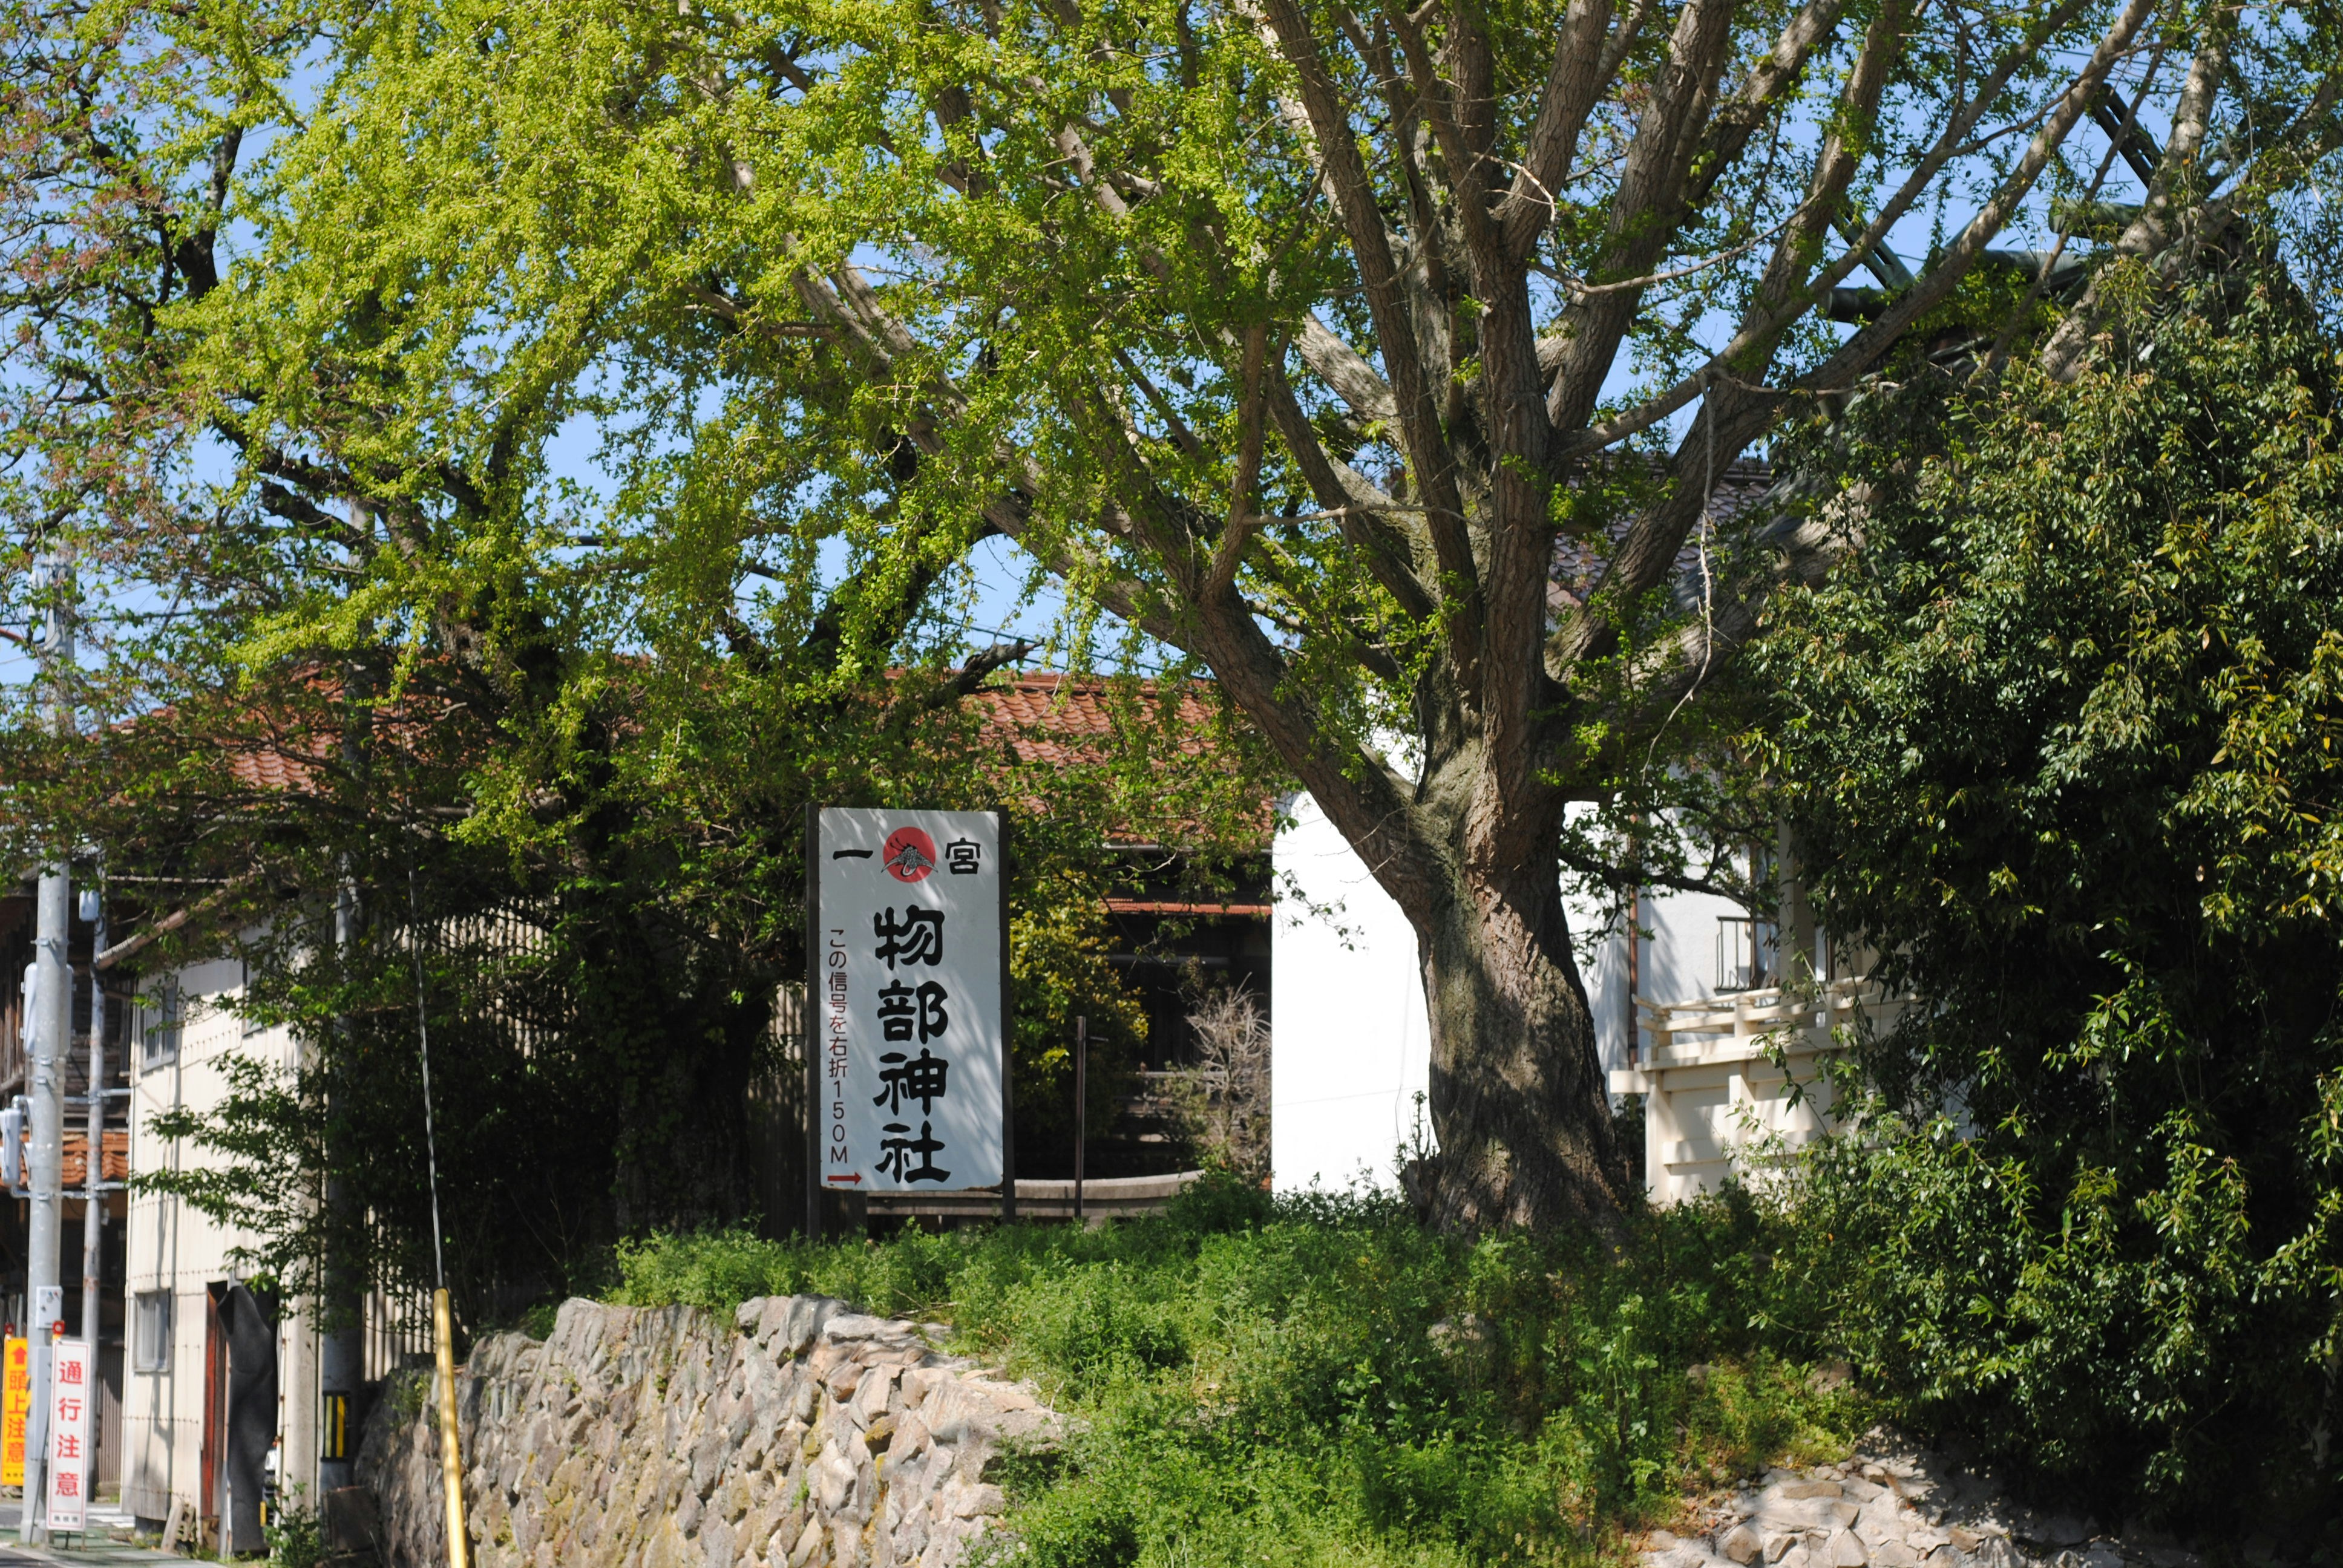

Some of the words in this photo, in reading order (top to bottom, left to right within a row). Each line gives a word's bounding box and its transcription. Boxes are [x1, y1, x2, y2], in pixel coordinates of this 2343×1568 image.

[833, 849, 873, 860] 一
[945, 837, 981, 875] 宮
[873, 904, 951, 1184] 物部神社
[7, 1370, 25, 1463] 頭上注意
[56, 1361, 83, 1497] 通行注意
